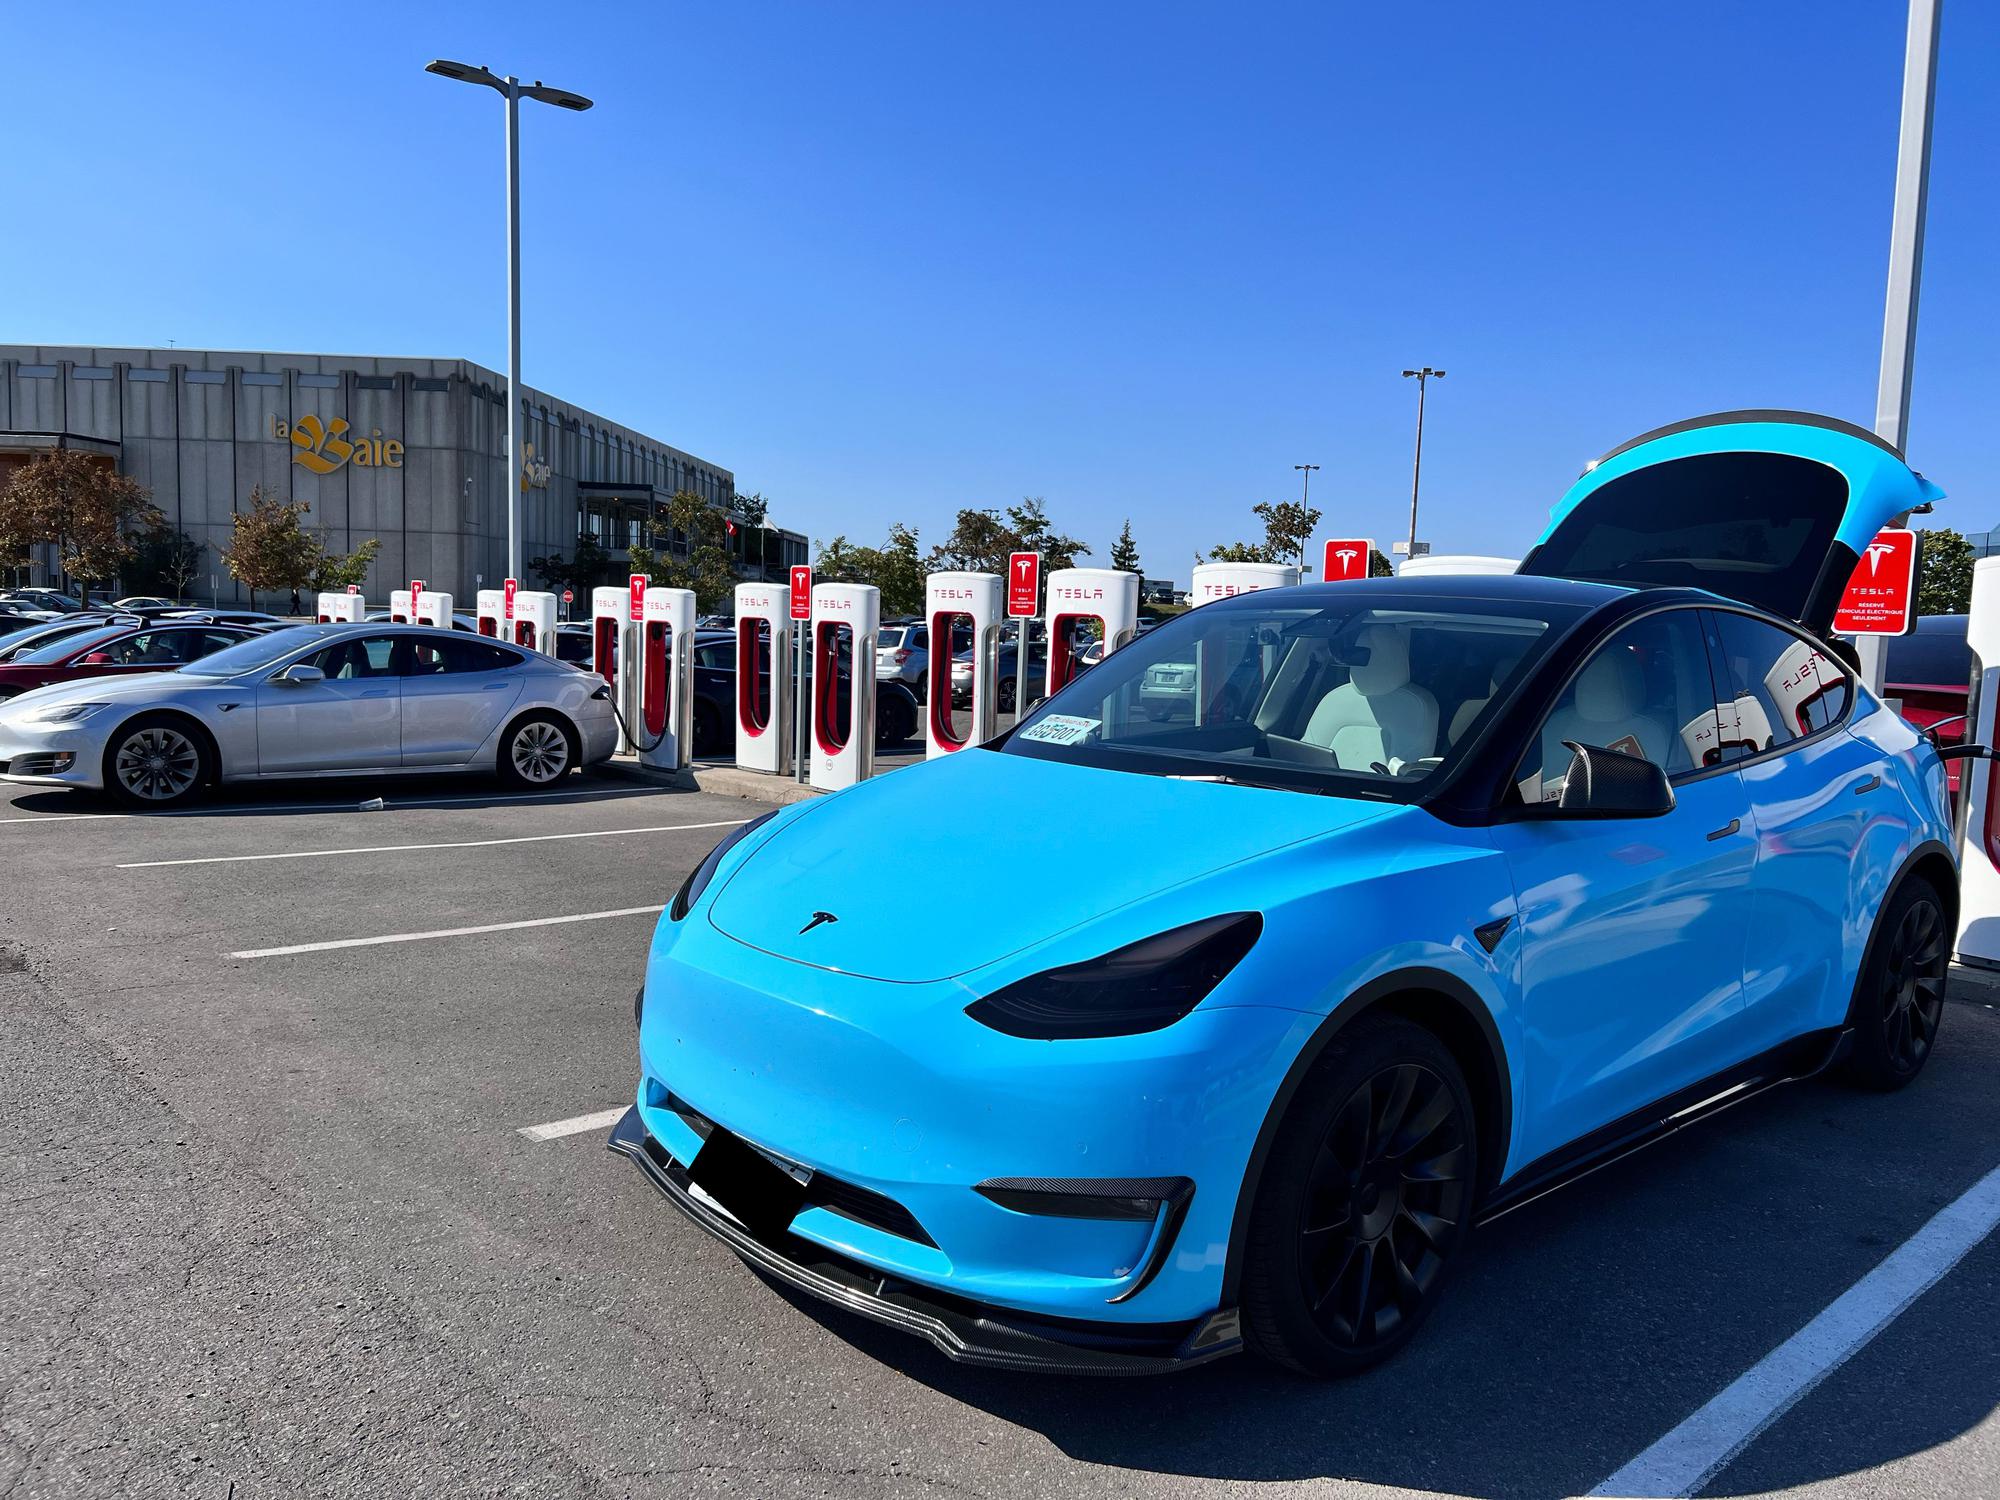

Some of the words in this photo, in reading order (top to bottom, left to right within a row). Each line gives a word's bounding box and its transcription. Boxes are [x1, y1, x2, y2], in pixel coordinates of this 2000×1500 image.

[270, 412, 288, 438] la
[934, 589, 973, 599] TESLA
[1057, 588, 1103, 600] TESLA
[1851, 587, 1894, 596] TESLA
[596, 600, 618, 608] TESLA
[646, 602, 672, 610] TESLA
[740, 598, 769, 607] TESLA
[817, 599, 851, 609] TESLA
